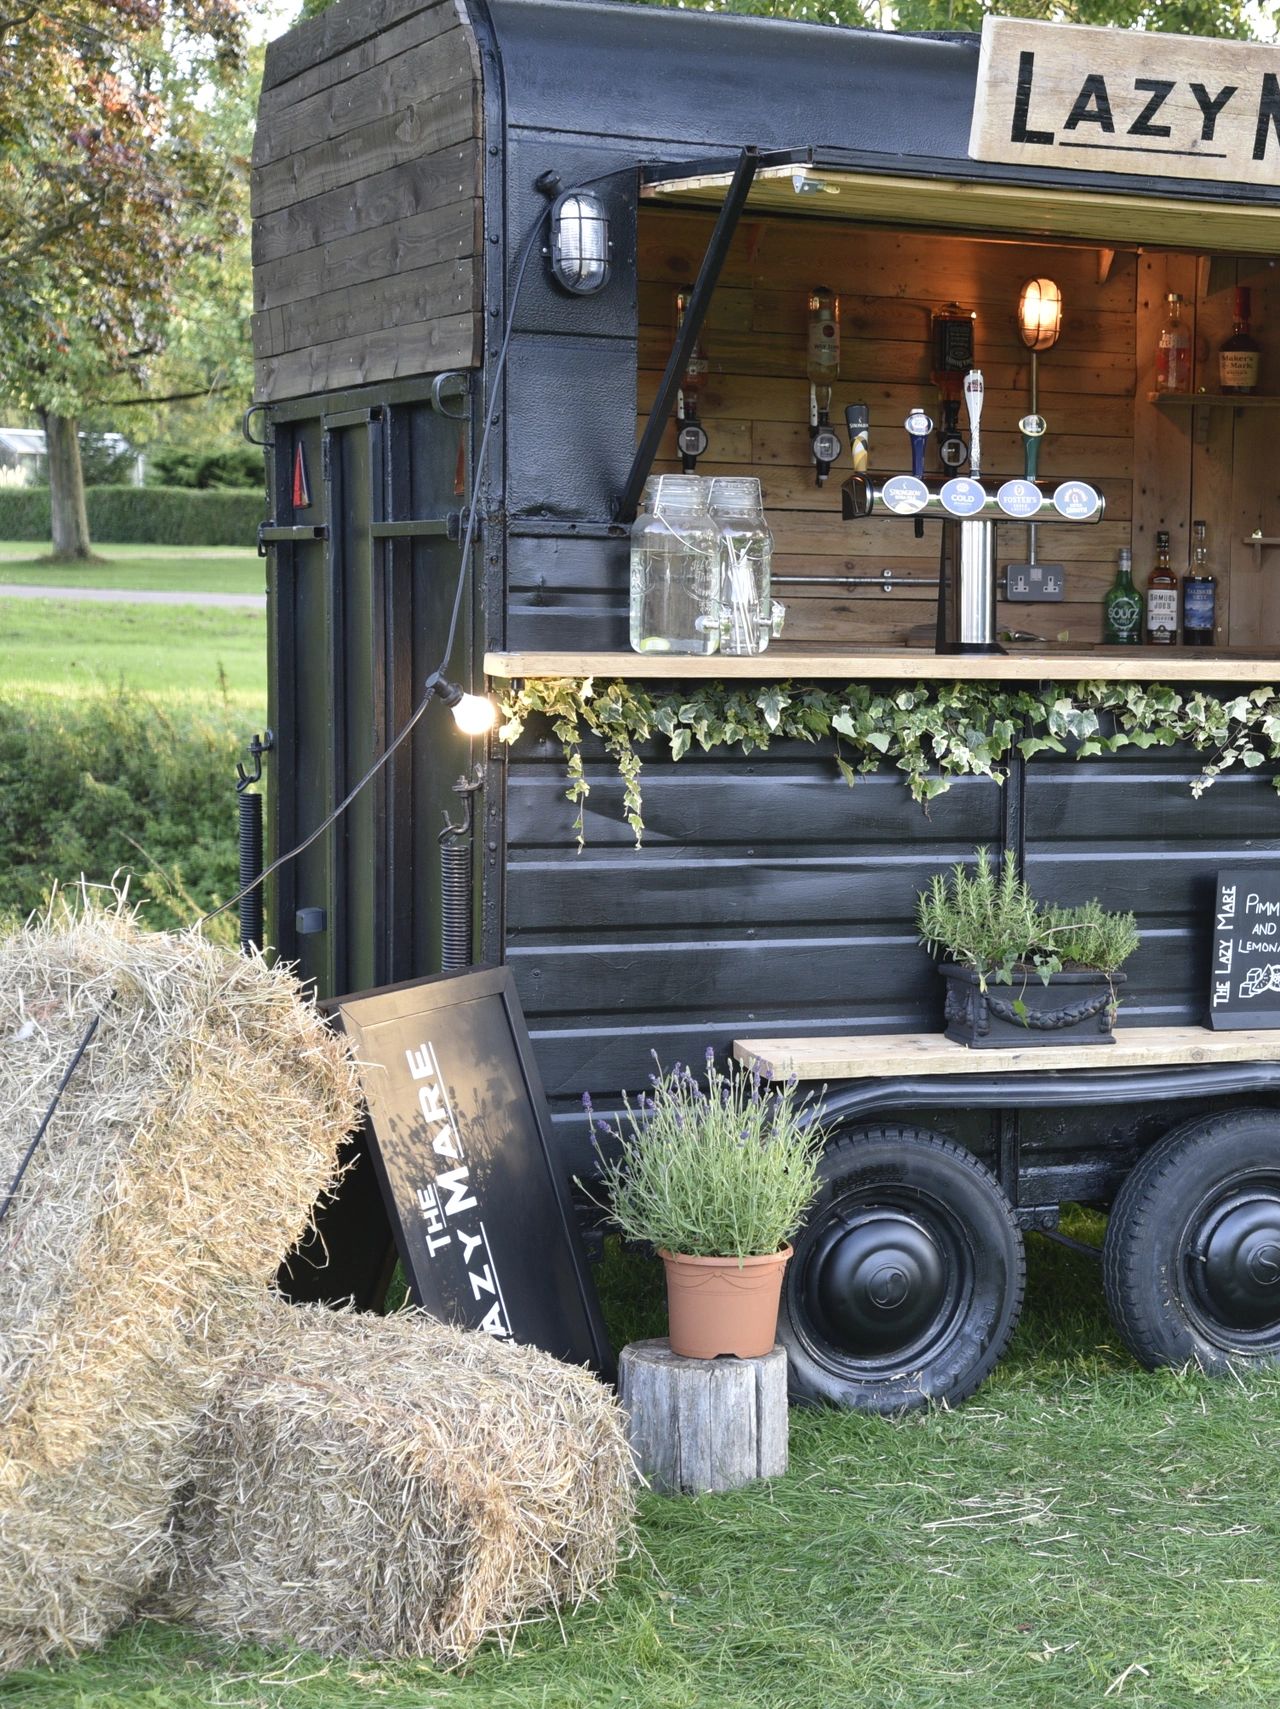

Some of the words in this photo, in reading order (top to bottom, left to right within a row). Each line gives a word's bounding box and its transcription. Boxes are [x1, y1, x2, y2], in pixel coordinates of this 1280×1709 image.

[1011, 51, 1237, 146] LAZY
[951, 494, 975, 502] COLD
[1003, 496, 1037, 504] FOSTER'S
[1217, 886, 1236, 929] MARE
[1252, 922, 1277, 936] AND
[1215, 938, 1234, 974] LAZY
[1213, 981, 1231, 1007] THE
[406, 1042, 478, 1216] MARE
[416, 1184, 451, 1258] THE
[457, 1229, 516, 1346] AZY
